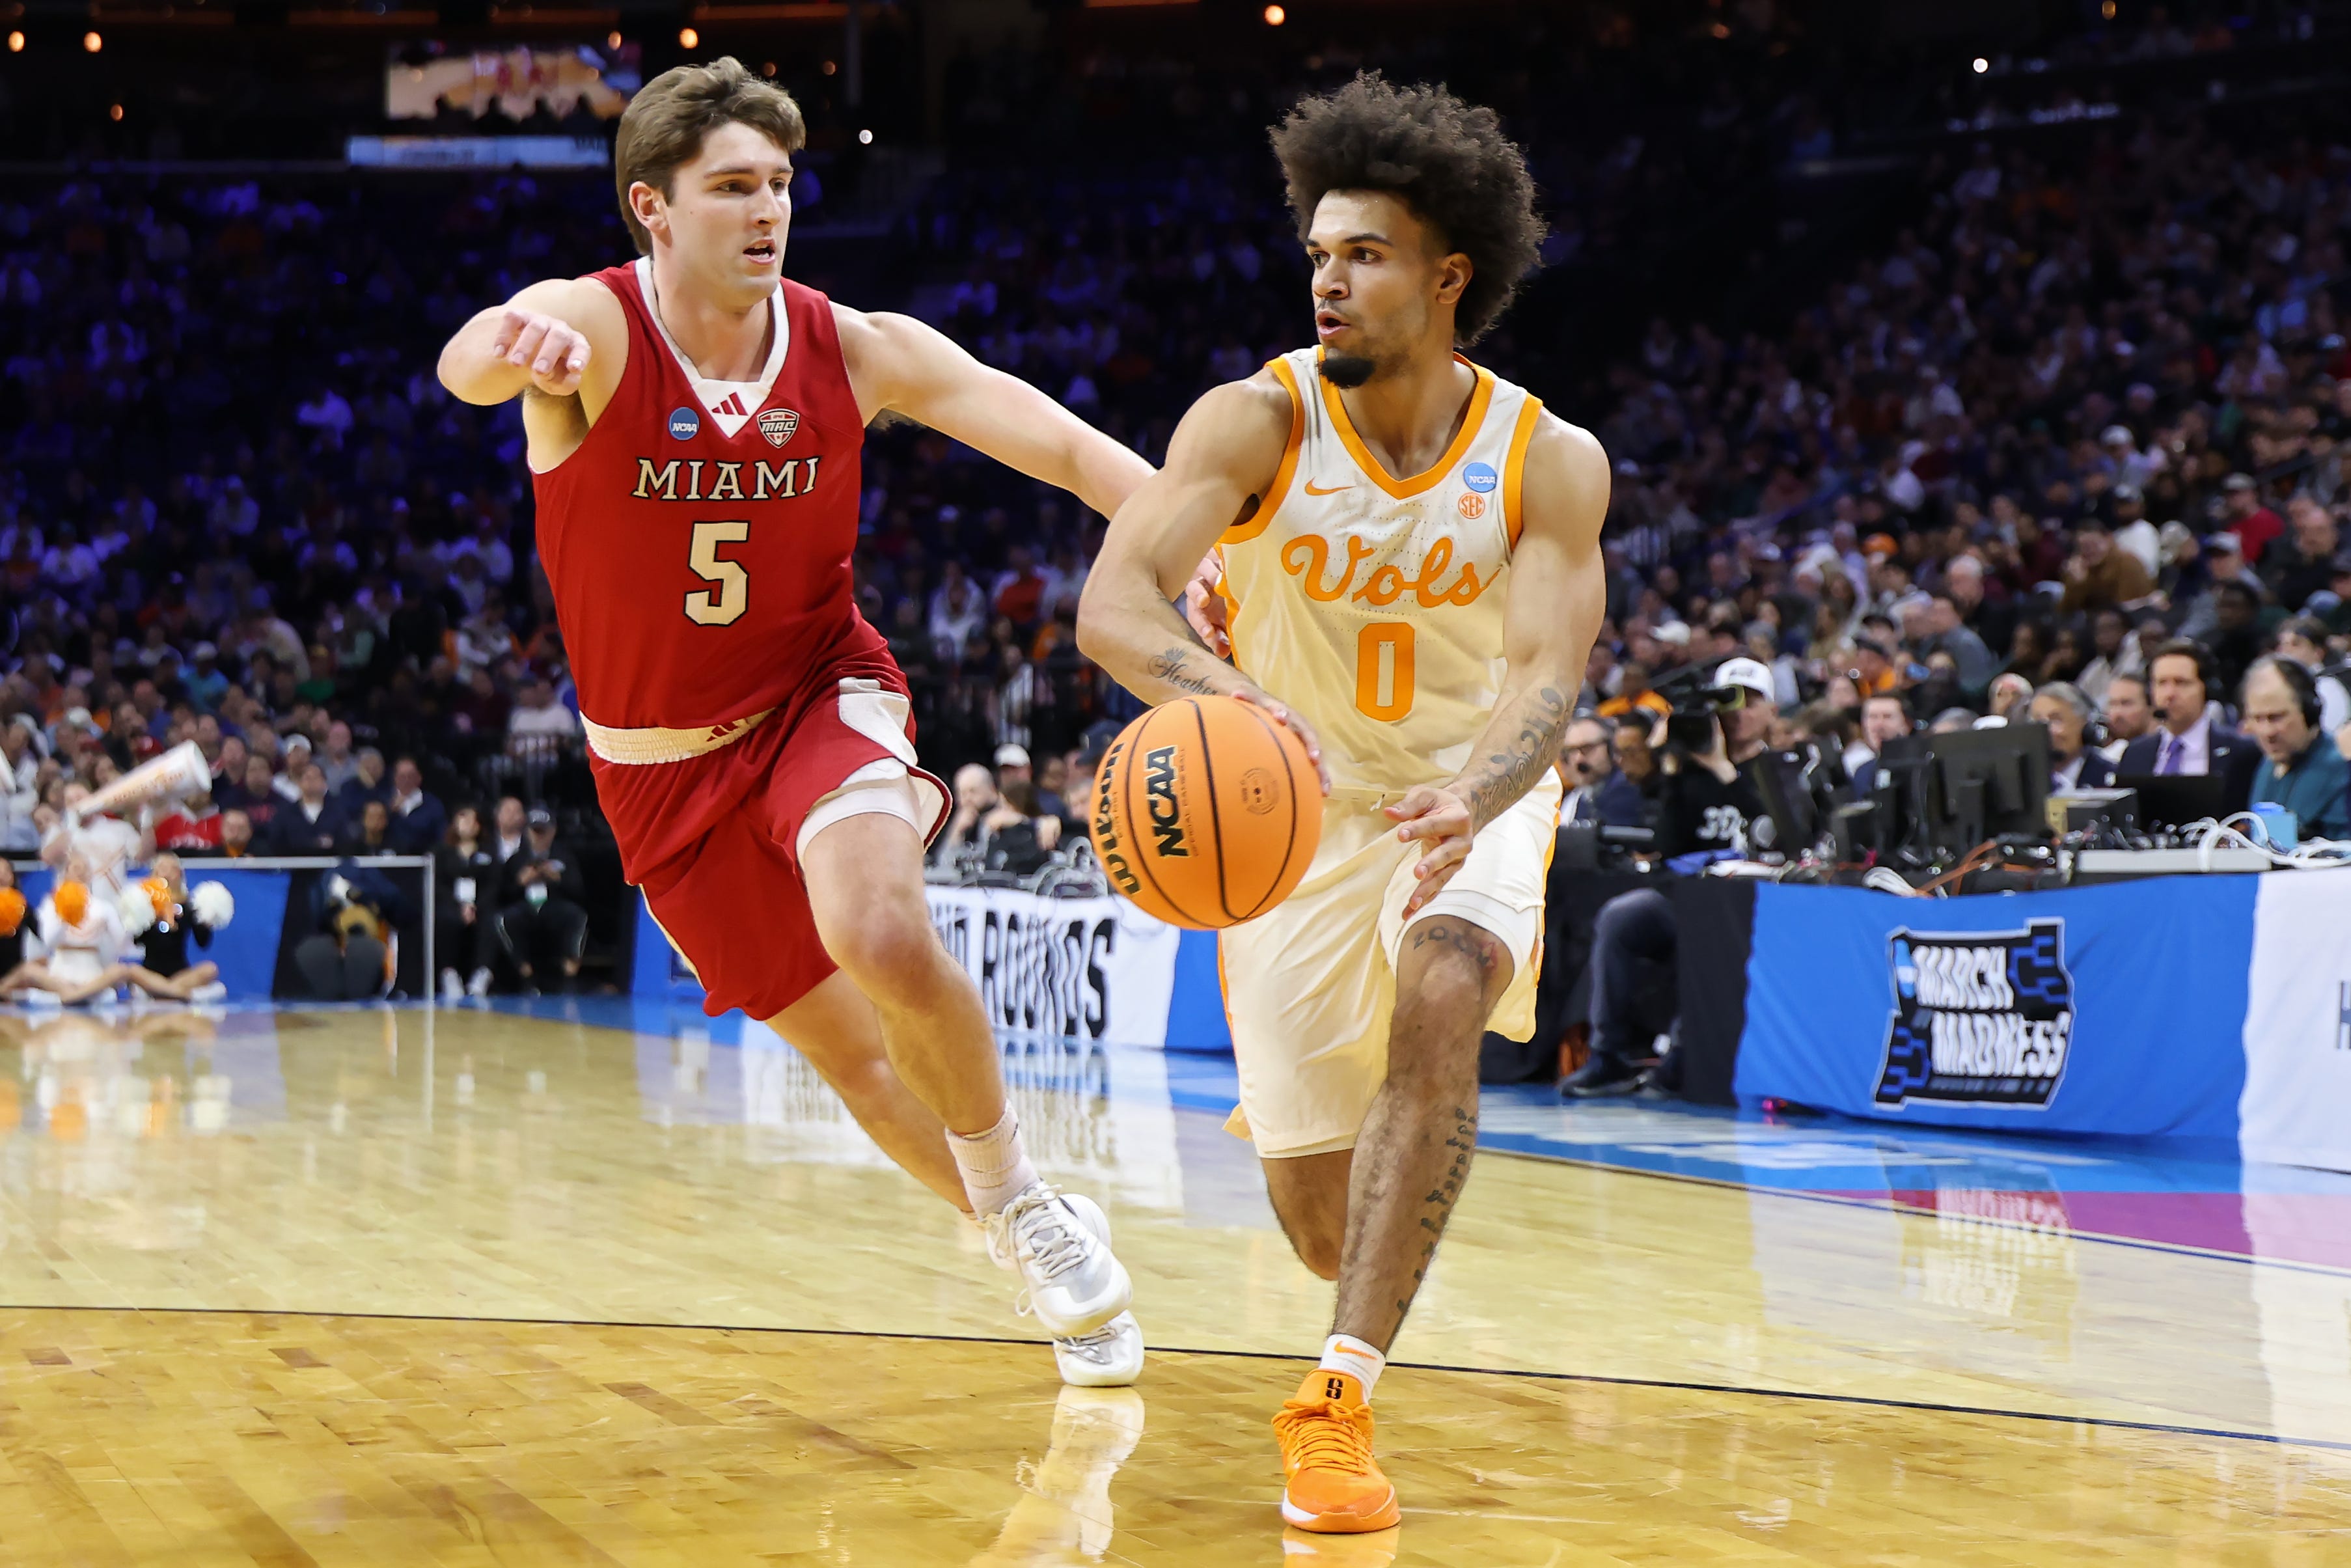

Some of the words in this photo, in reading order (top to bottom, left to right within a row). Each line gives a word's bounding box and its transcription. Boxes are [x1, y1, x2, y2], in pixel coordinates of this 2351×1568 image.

[672, 422, 698, 433] NCAA
[761, 421, 795, 432] MAC
[630, 454, 821, 501] MIAMI
[1461, 495, 1483, 517] SEC
[1468, 475, 1496, 484] NCAA
[683, 520, 751, 628] 5
[1281, 534, 1504, 608] Vols
[1356, 622, 1415, 722] 0
[1144, 745, 1190, 859] NCAA
[982, 910, 1117, 1038] ROUNDS
[1911, 944, 2014, 1010] MARCH
[1930, 1011, 2071, 1078] MADNESS
